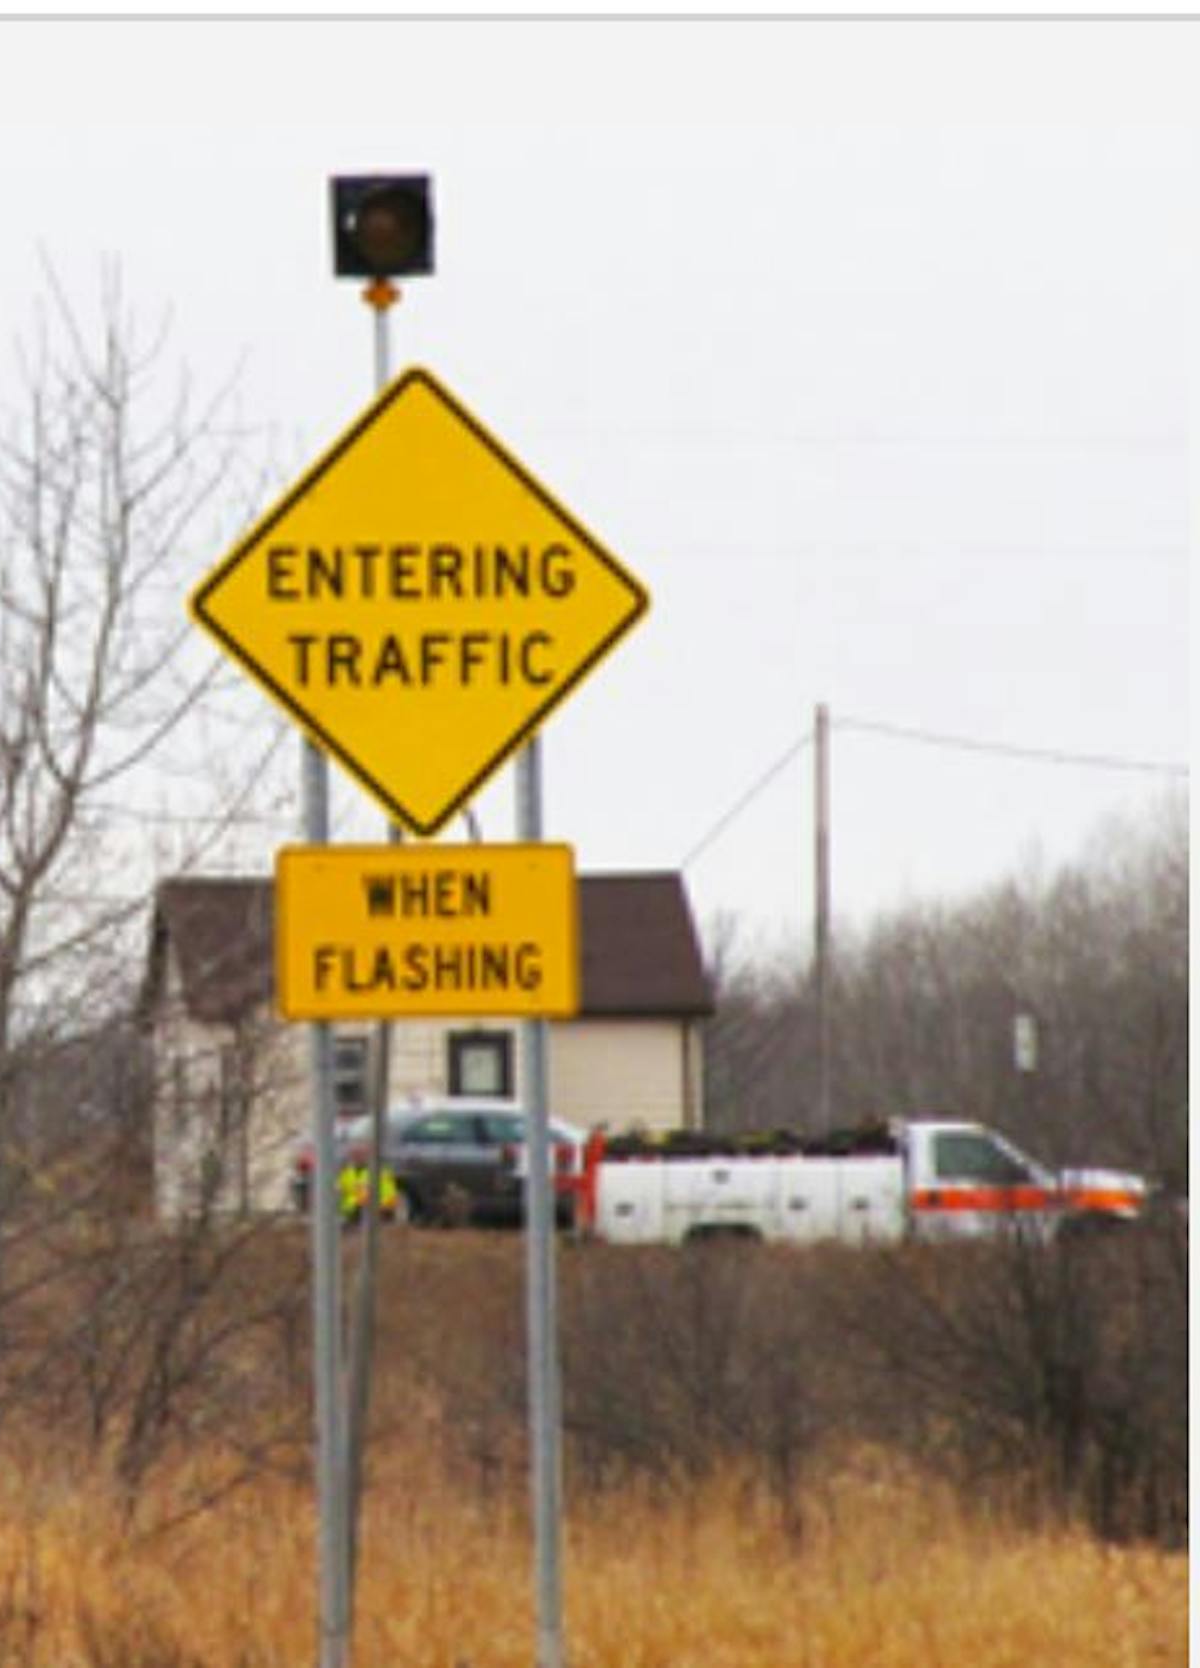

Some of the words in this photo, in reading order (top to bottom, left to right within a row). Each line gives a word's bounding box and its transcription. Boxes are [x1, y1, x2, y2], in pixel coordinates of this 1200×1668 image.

[266, 544, 577, 600] ENTERING
[288, 630, 556, 687] TRAFFIC
[363, 870, 491, 917] WHEN
[313, 942, 543, 992] FLASHING
